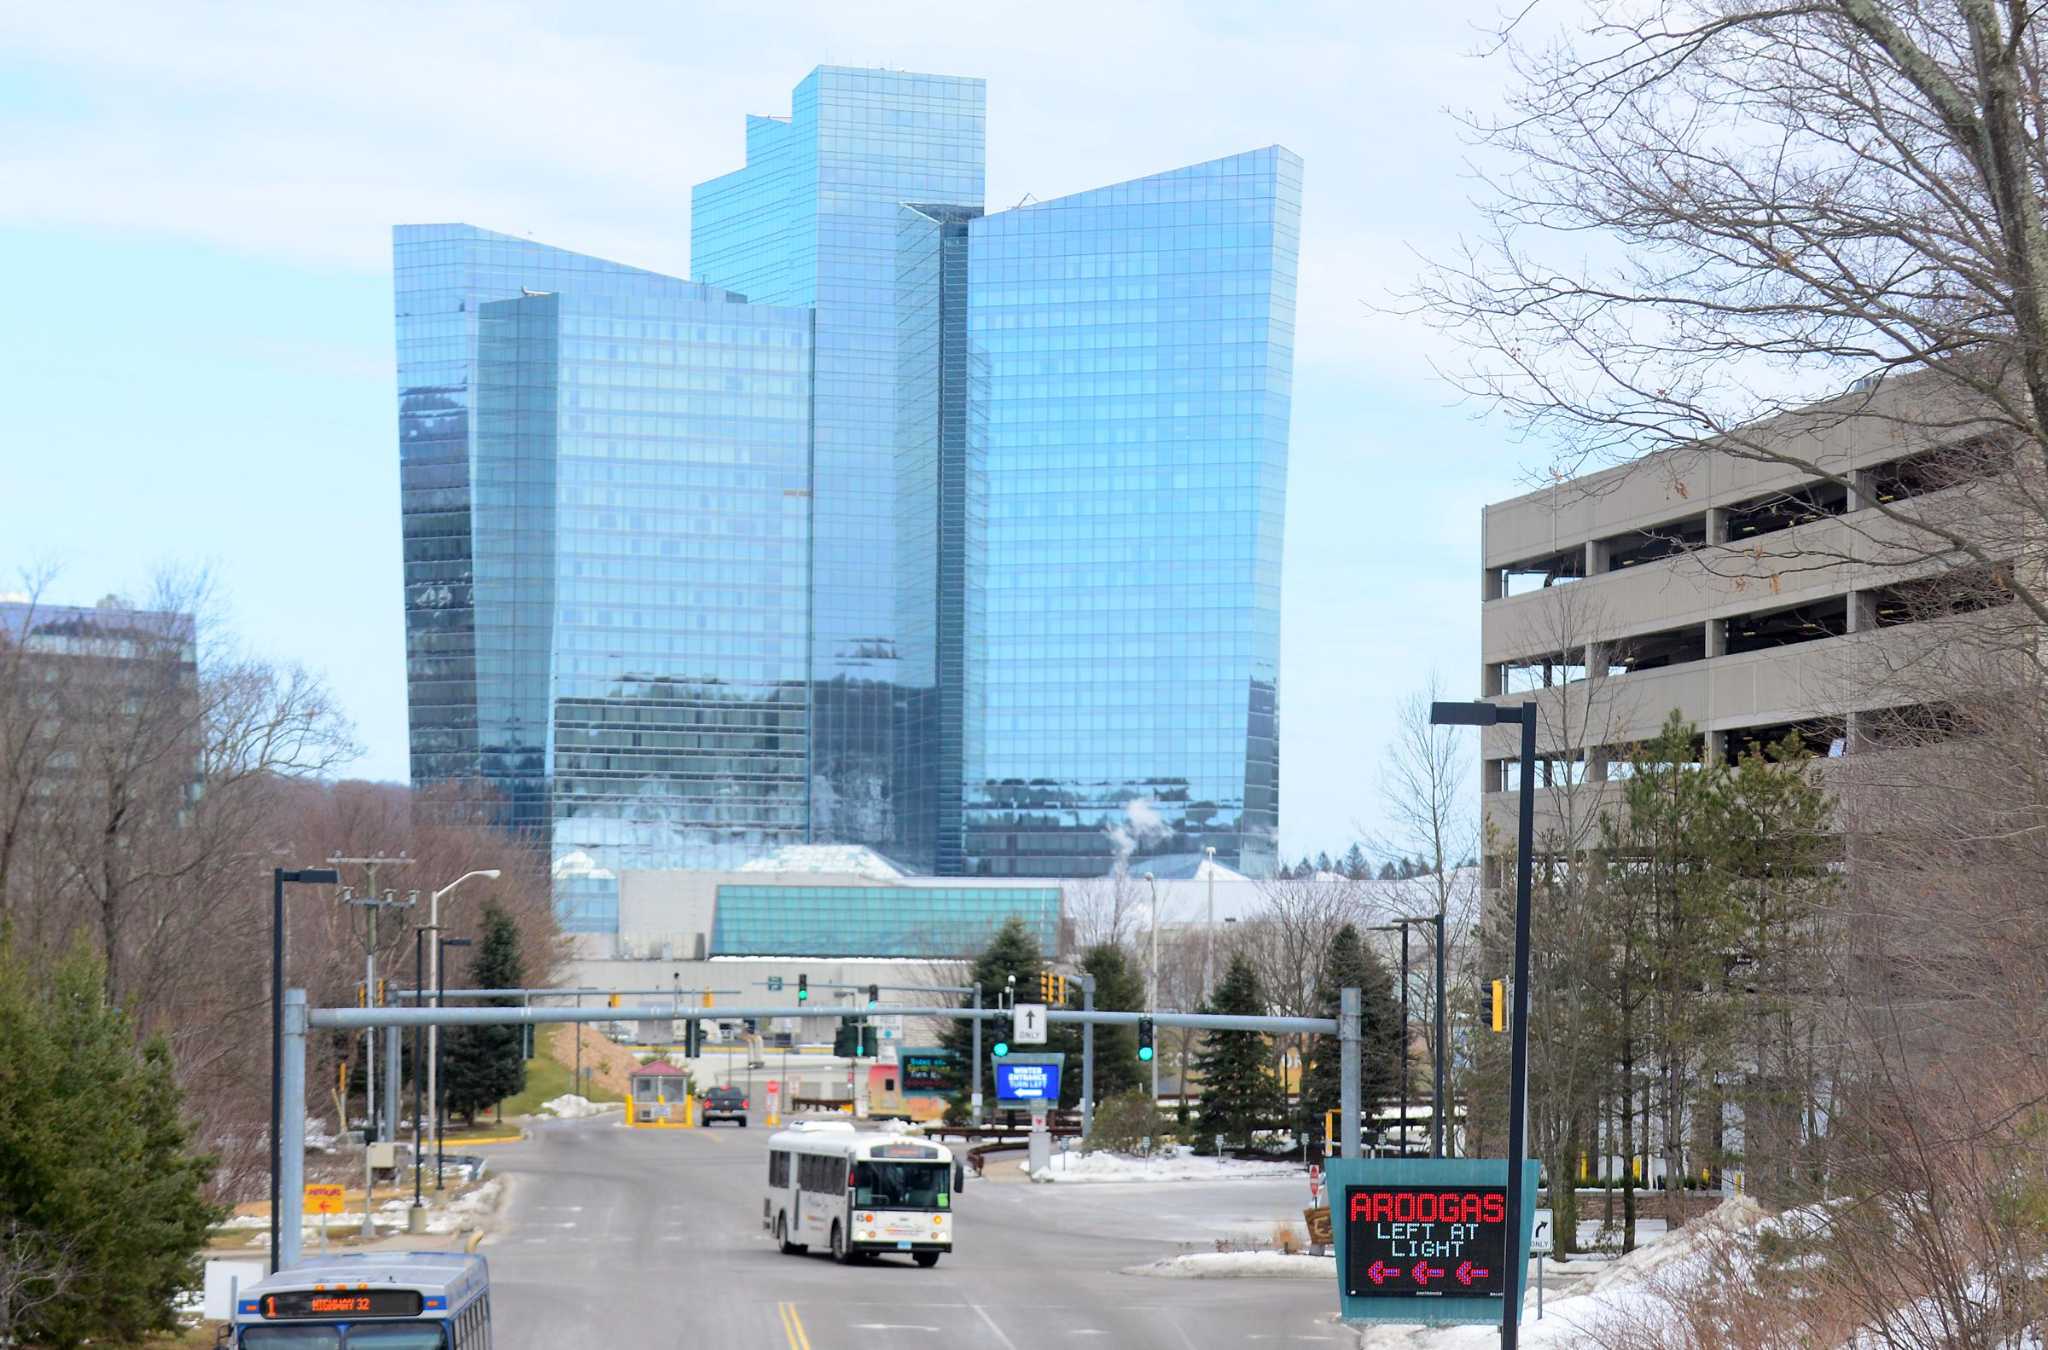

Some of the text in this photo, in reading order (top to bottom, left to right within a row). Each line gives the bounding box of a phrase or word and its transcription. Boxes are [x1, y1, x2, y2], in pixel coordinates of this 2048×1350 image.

[1018, 1032, 1041, 1040] ONLY
[1008, 1073, 1047, 1081] ENTRANCE
[1013, 1066, 1042, 1074] WINTER
[1350, 1193, 1504, 1222] AROOGAS
[1377, 1223, 1479, 1240] LEFT AT
[1391, 1240, 1464, 1257] LIGHT
[266, 1296, 277, 1318] 1
